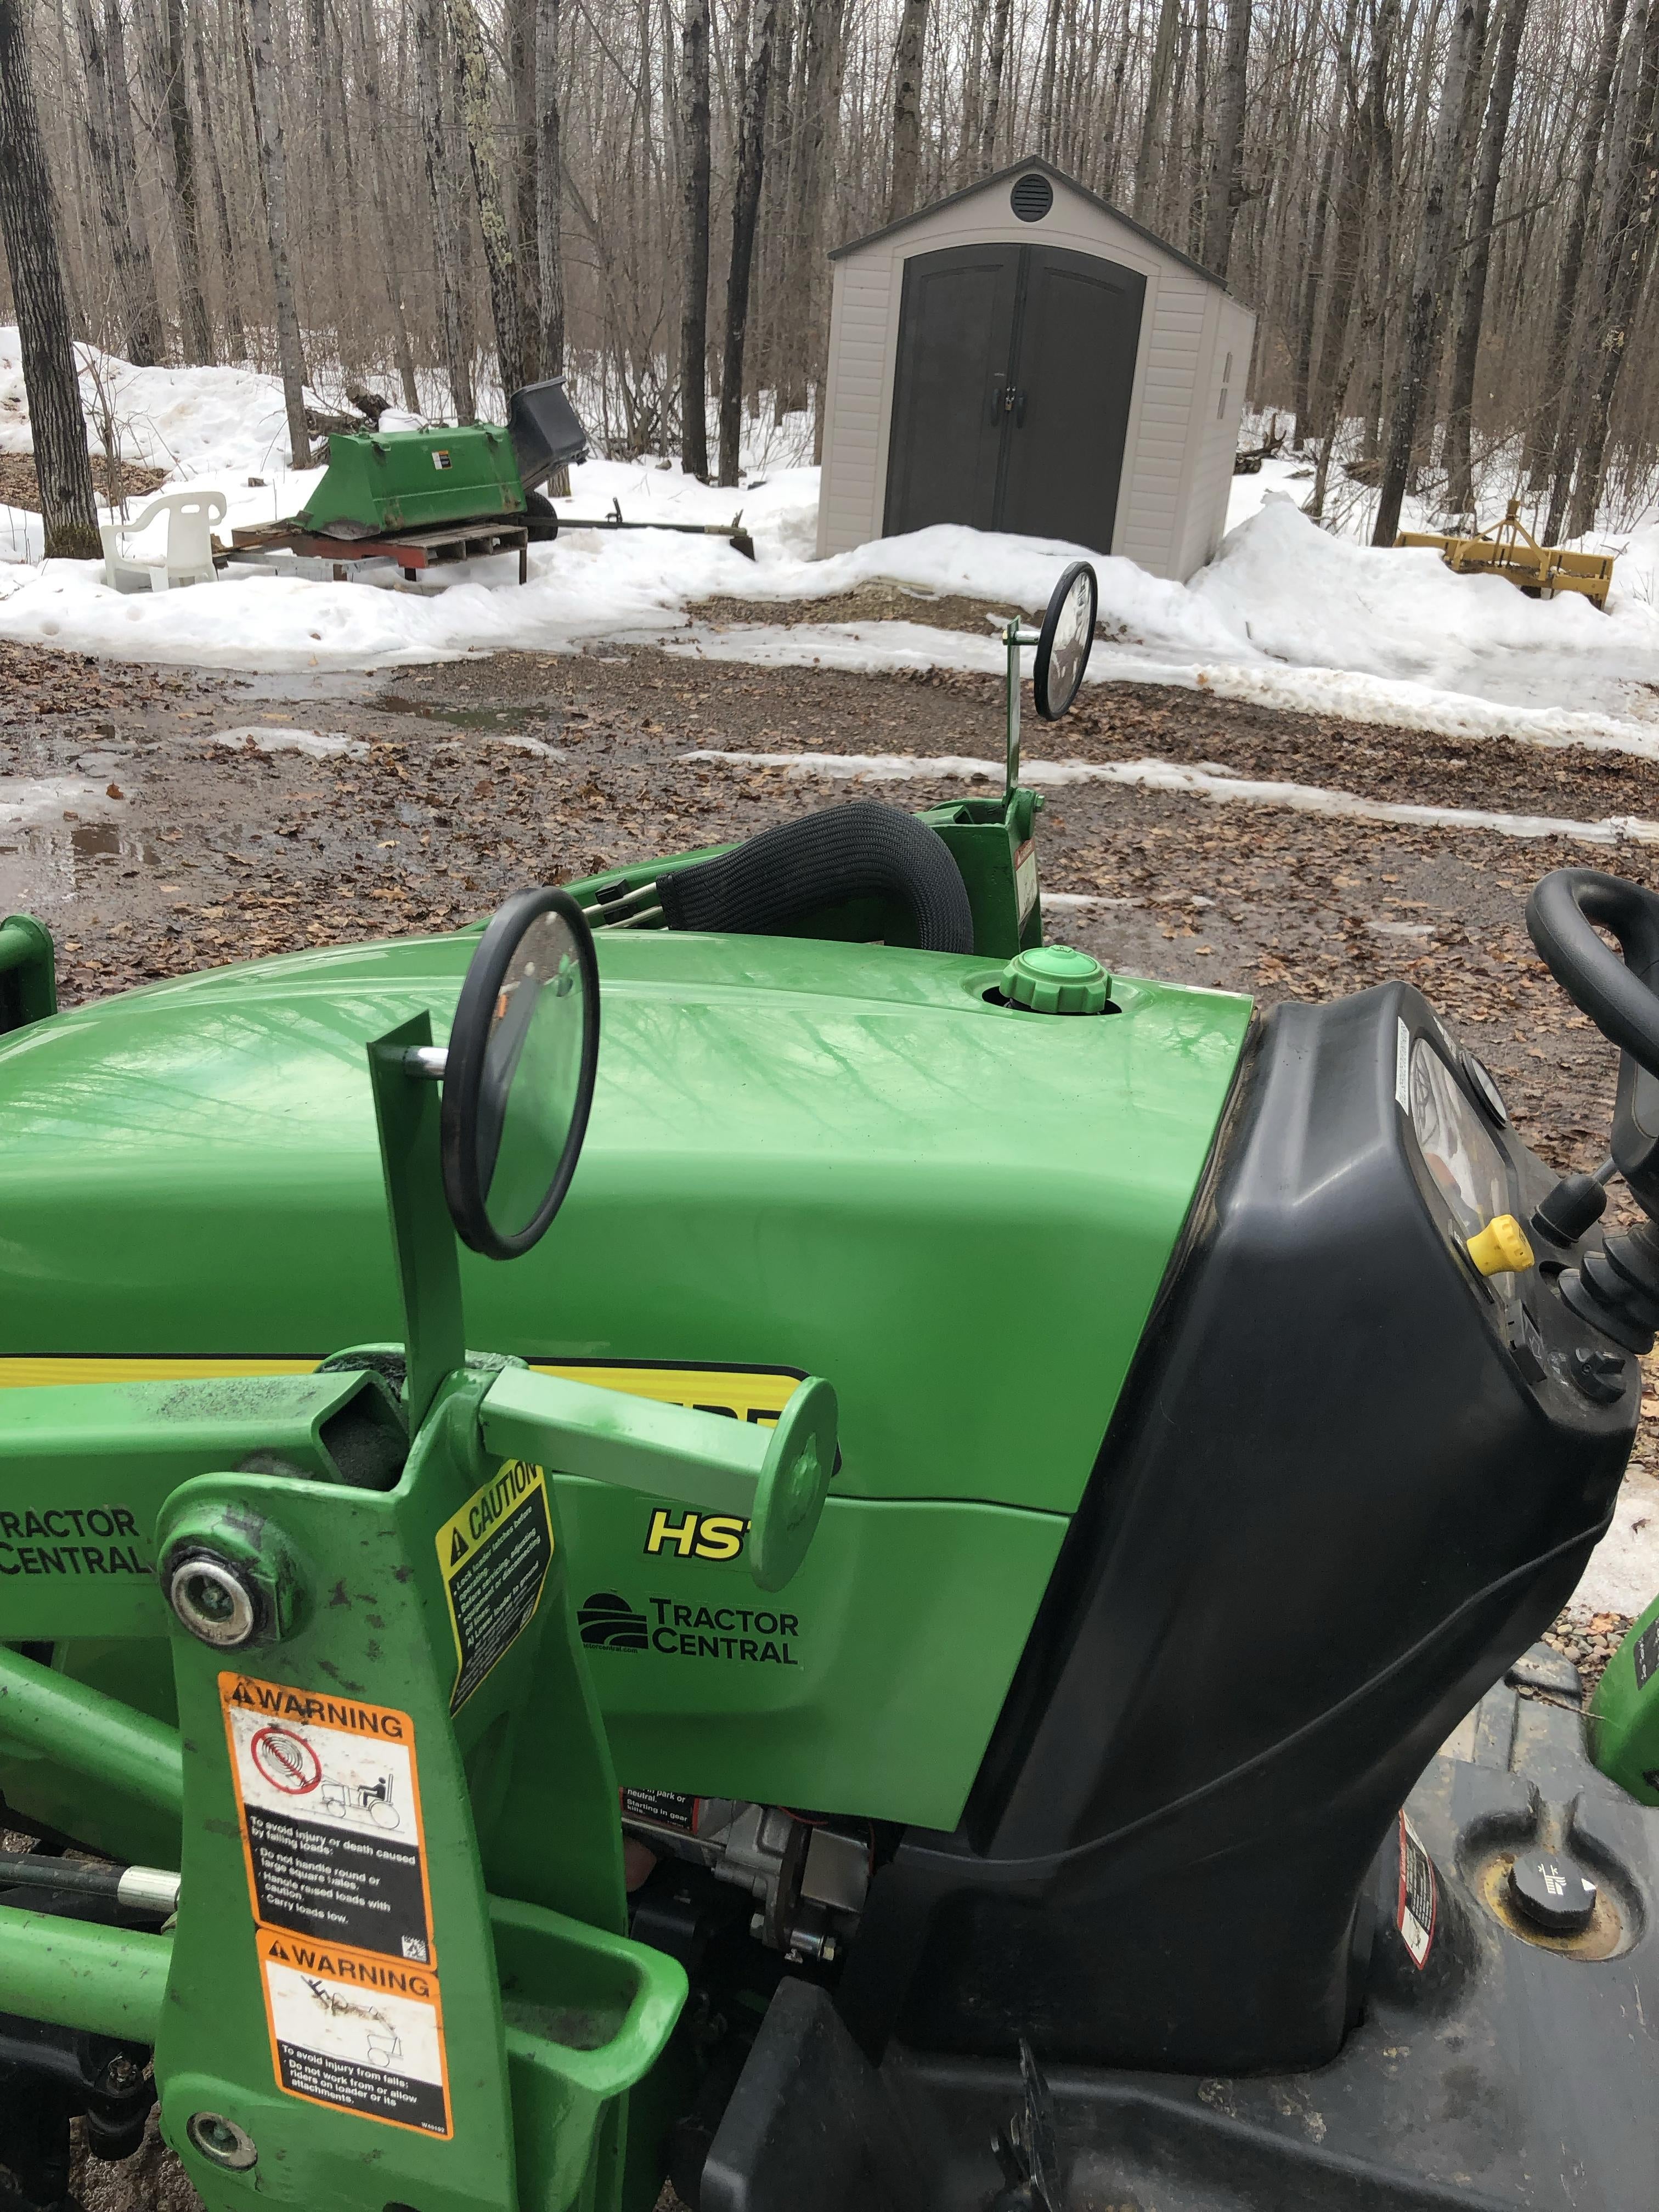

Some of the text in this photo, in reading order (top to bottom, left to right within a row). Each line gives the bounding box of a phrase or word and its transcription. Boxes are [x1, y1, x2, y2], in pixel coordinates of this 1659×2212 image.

[469, 1460, 537, 1540] CAUTION
[0, 1509, 139, 1537] RACTOR
[644, 1508, 752, 1561] HS
[0, 1541, 153, 1575] CENTRAL
[457, 1570, 472, 1590] Lock
[492, 1526, 514, 1552] latches
[514, 1506, 532, 1528] before
[461, 1588, 481, 1613] Before
[511, 1527, 536, 1559] adjusting
[464, 1585, 494, 1624] equipment
[495, 1578, 501, 1589] or
[503, 1536, 540, 1581] disconnecting
[475, 1614, 493, 1638] Lower
[513, 1585, 519, 1594] to
[520, 1560, 538, 1588] ground
[649, 1597, 799, 1637] TRACTOR
[652, 1627, 799, 1665] CENTRAL
[256, 1686, 403, 1738] WARNING
[627, 1798, 658, 1814] Starting
[670, 1813, 687, 1821] gear
[657, 1790, 675, 1800] park
[250, 1815, 415, 1865] To avoid injury or death caused
[251, 1825, 264, 1838] by
[266, 1830, 297, 1850] falling
[260, 1847, 381, 1886] Do not handle round or
[261, 1857, 287, 1872] large
[289, 1867, 325, 1882] square
[263, 1871, 391, 1912] Handle raised loads with
[266, 1894, 294, 1911] Carry
[296, 1903, 325, 1918] loads
[292, 1944, 430, 1997] WARNING
[282, 2044, 294, 2056] To
[296, 2051, 323, 2065] avoid
[325, 2058, 354, 2075] injury
[357, 2068, 381, 2081] from
[289, 2059, 302, 2070] Do
[304, 2066, 320, 2077] not
[323, 2072, 347, 2085] work
[350, 2078, 374, 2091] from
[390, 2090, 417, 2103] allow
[290, 2069, 397, 2107] riders on loader or its
